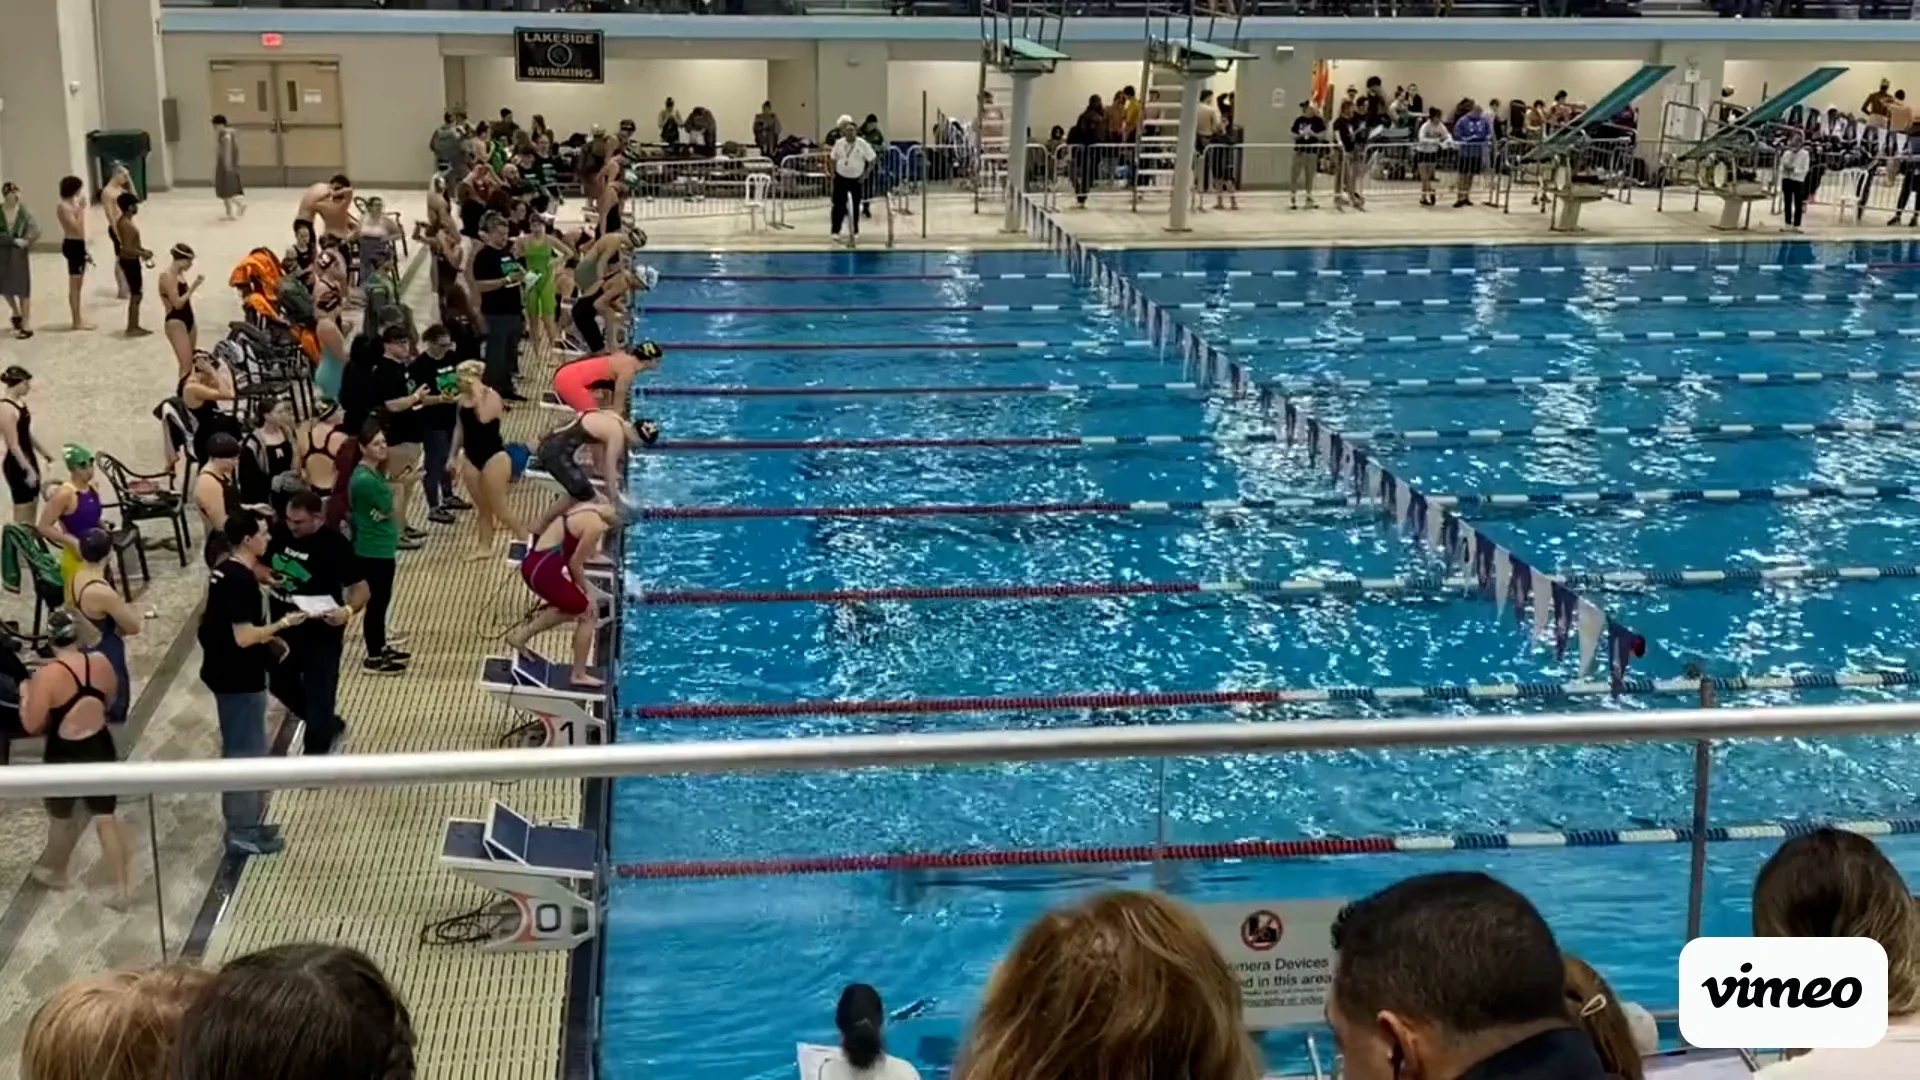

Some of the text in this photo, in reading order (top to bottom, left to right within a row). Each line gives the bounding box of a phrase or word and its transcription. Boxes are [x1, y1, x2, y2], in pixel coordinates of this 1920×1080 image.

[524, 32, 594, 44] LAKESIDE
[527, 66, 593, 78] SWIMMING
[560, 721, 575, 746] 1
[1275, 958, 1329, 971] Devices
[1258, 976, 1270, 987] in
[1274, 974, 1297, 986] this
[1301, 974, 1332, 984] area
